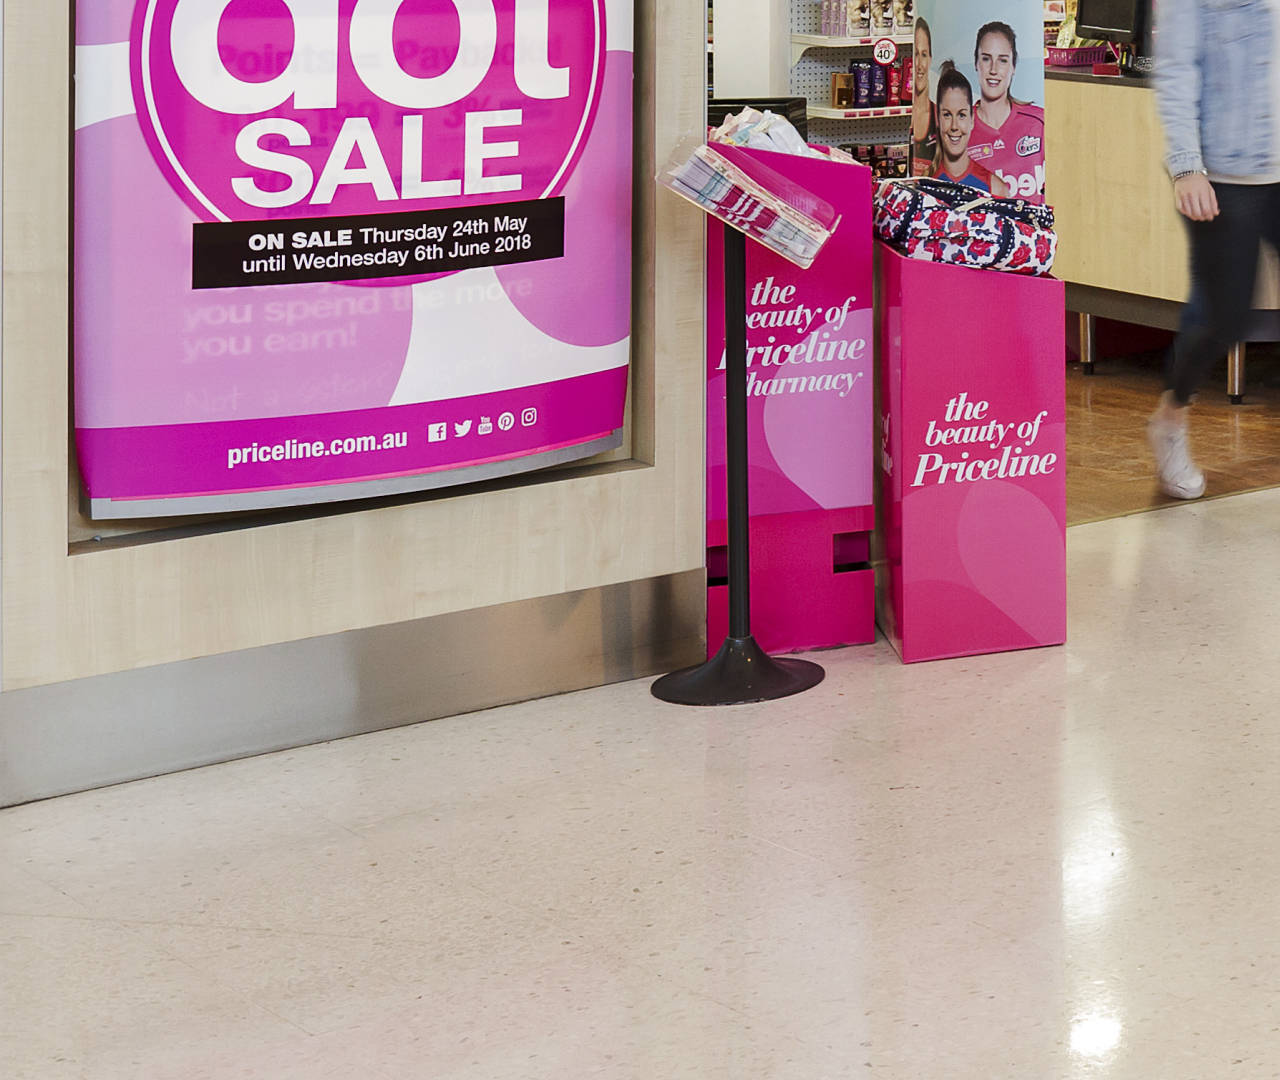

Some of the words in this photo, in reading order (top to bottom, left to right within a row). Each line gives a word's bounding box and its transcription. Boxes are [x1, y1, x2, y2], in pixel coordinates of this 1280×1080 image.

[231, 109, 523, 208] SALE
[248, 233, 285, 251] ON
[291, 229, 353, 249] SALE
[359, 226, 448, 246] Thursday
[452, 220, 490, 238] 24th
[494, 215, 528, 235] May
[242, 253, 287, 273] until
[293, 248, 410, 272] Wednesday
[414, 244, 444, 262] 6th
[448, 238, 491, 258] June
[495, 233, 532, 253] 2018
[751, 276, 796, 306] the
[745, 304, 823, 334] eauty
[824, 296, 857, 331] of
[746, 371, 864, 398] harmacy
[944, 392, 989, 423] the
[925, 420, 1014, 449] beauty
[1016, 410, 1048, 446] of
[228, 430, 408, 469] priceline.com.au
[910, 445, 1057, 487] Priceline
